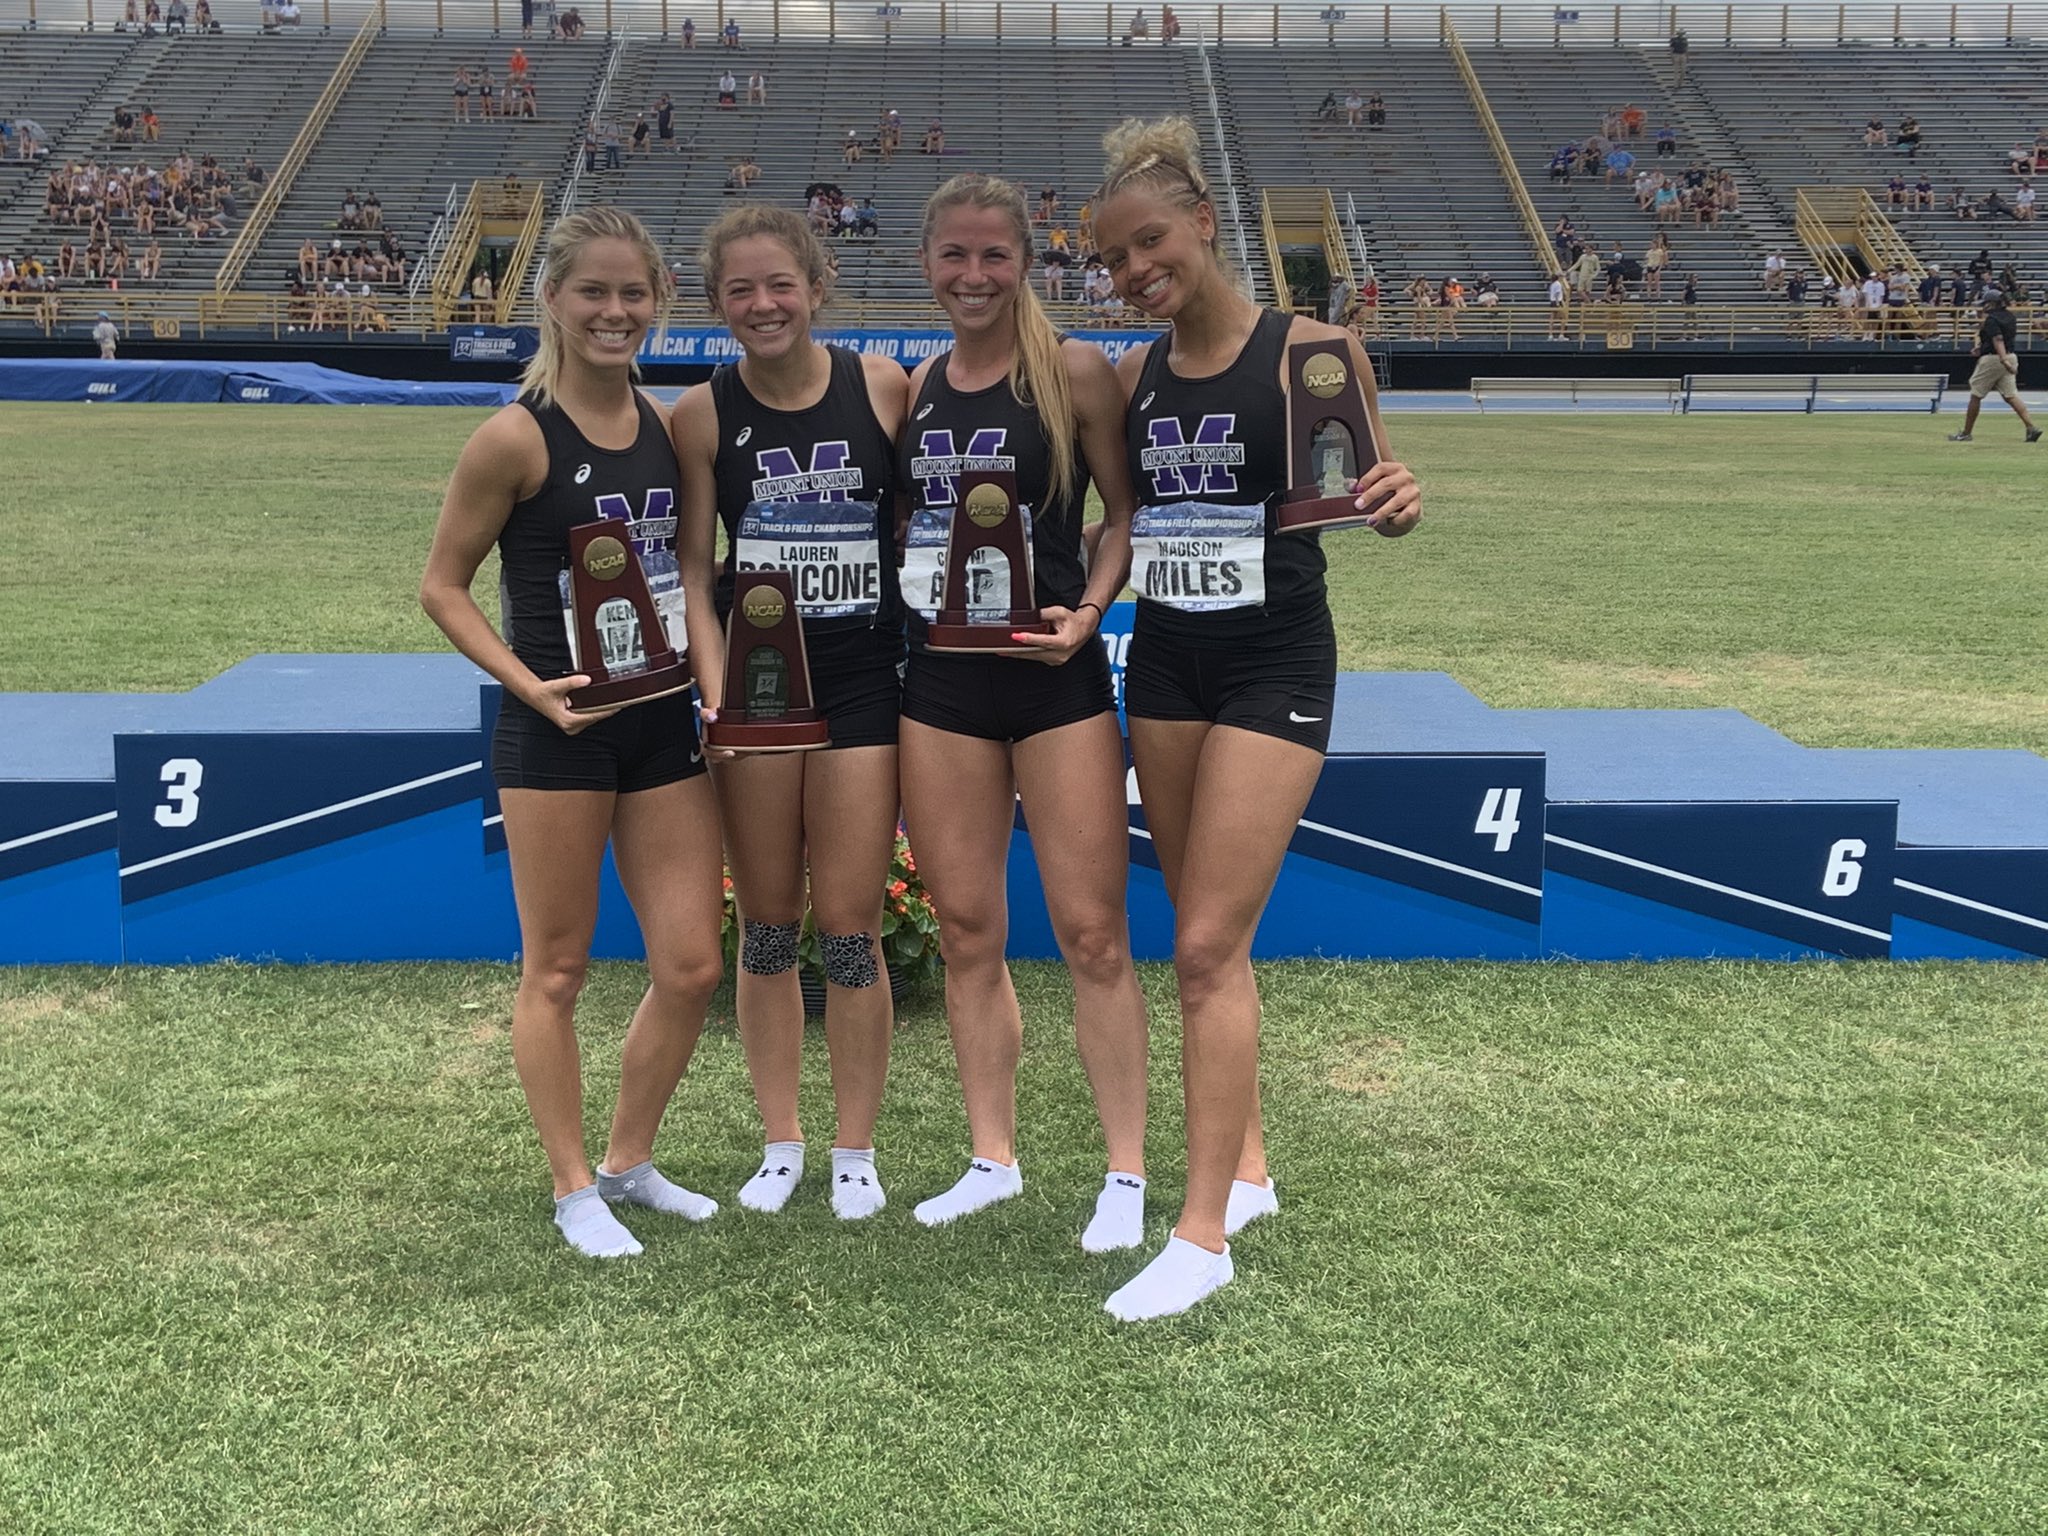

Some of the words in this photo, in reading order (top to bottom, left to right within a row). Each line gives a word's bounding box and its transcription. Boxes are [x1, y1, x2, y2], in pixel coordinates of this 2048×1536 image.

[156, 320, 178, 336] 30
[650, 337, 695, 356] NCAA
[862, 339, 899, 357] AND
[1610, 332, 1630, 346] 30
[87, 382, 117, 395] GILL
[1307, 371, 1346, 389] NCAA
[241, 386, 270, 399] GILL
[1142, 449, 1193, 467] MOUNT
[1193, 446, 1242, 464] UNION
[913, 458, 963, 475] MOUNT
[754, 478, 812, 499] MOUNT
[812, 471, 860, 491] UNION
[760, 523, 785, 533] TRACK
[791, 523, 813, 533] FIELD
[813, 523, 873, 534] CHAMPIONSHIPS
[780, 546, 838, 561] LAUREN
[1158, 541, 1222, 557] MADISON
[589, 552, 626, 572] NCAA
[930, 571, 993, 604] AP
[1145, 560, 1242, 597] MILES
[746, 605, 784, 617] NCAA
[154, 758, 203, 827] 3
[1475, 788, 1522, 852] 4
[1822, 838, 1867, 897] 6
